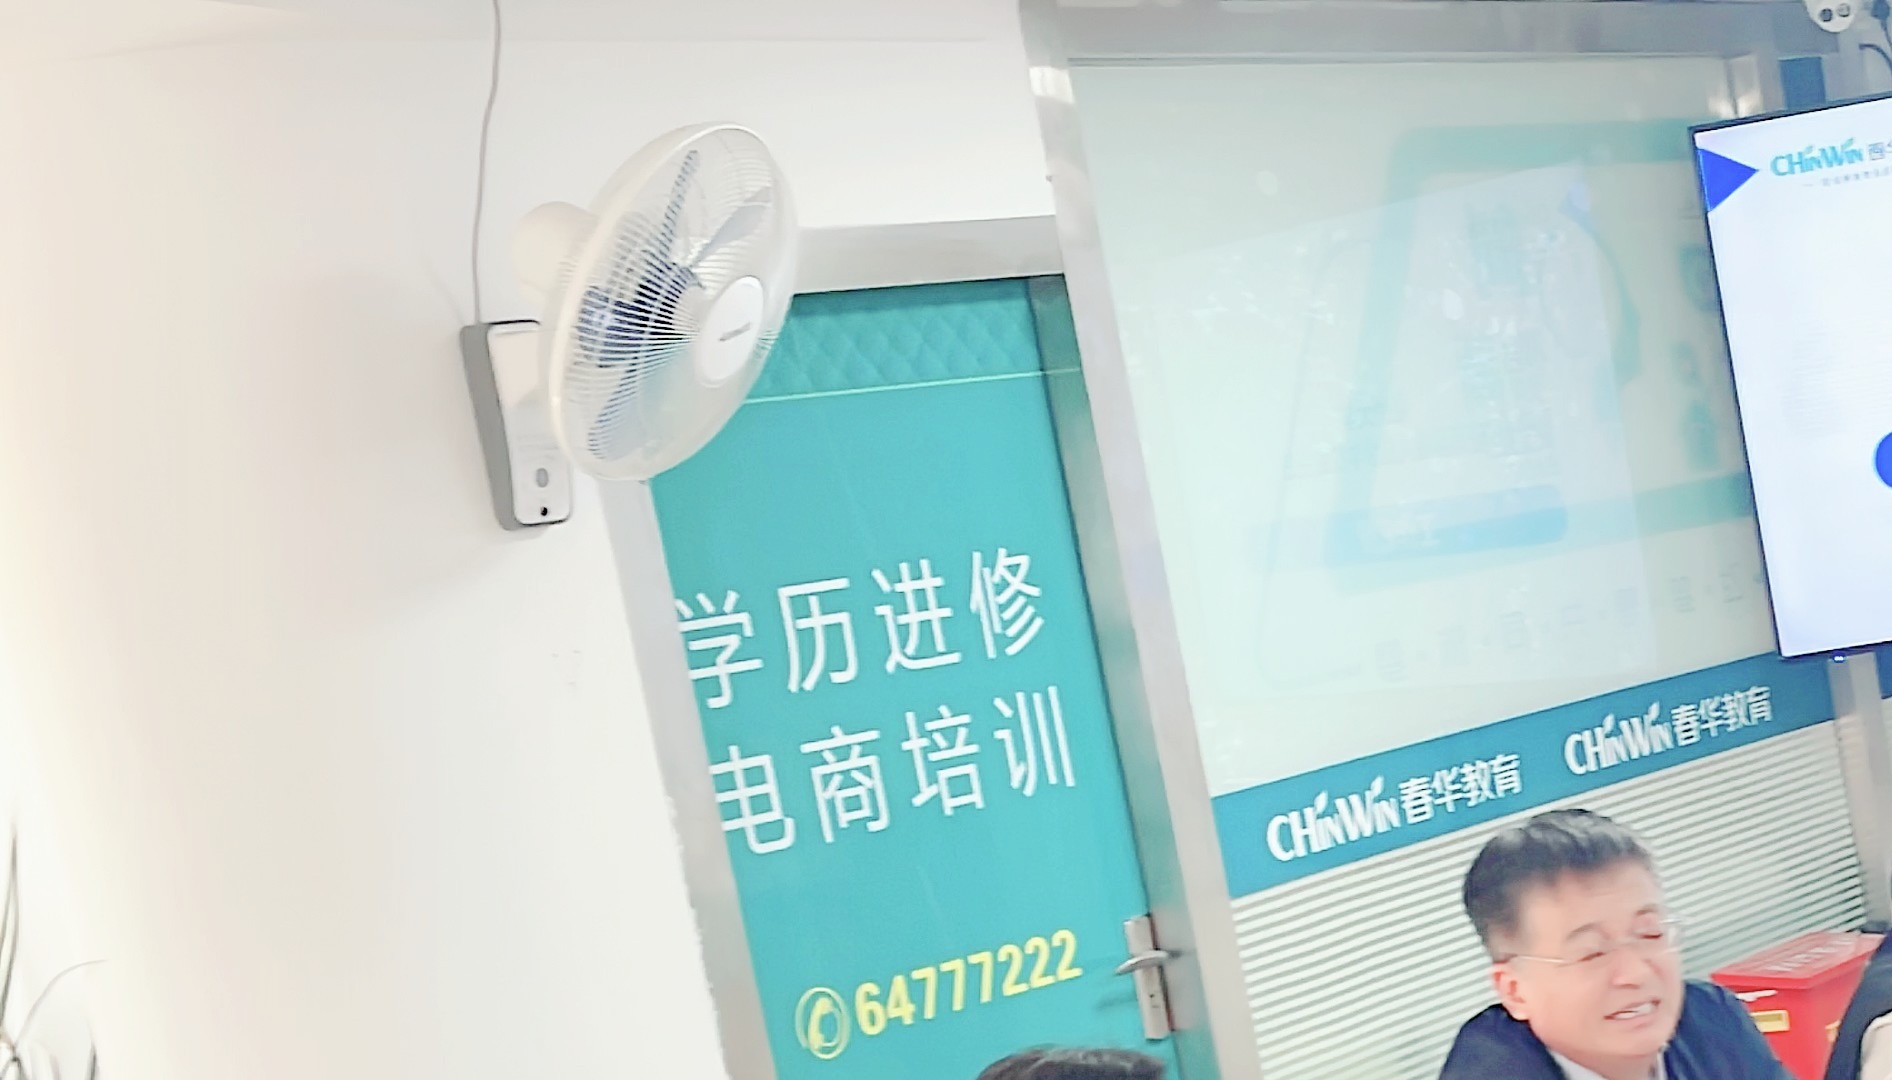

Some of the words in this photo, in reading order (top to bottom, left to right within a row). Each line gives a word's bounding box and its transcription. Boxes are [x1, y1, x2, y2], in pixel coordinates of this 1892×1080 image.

[675, 547, 1045, 709] 学历进修
[708, 685, 1075, 854] 电商培训
[1671, 685, 1773, 748] 春华教育
[1399, 753, 1522, 826] 春华教育
[854, 928, 1083, 1036] 64777222
